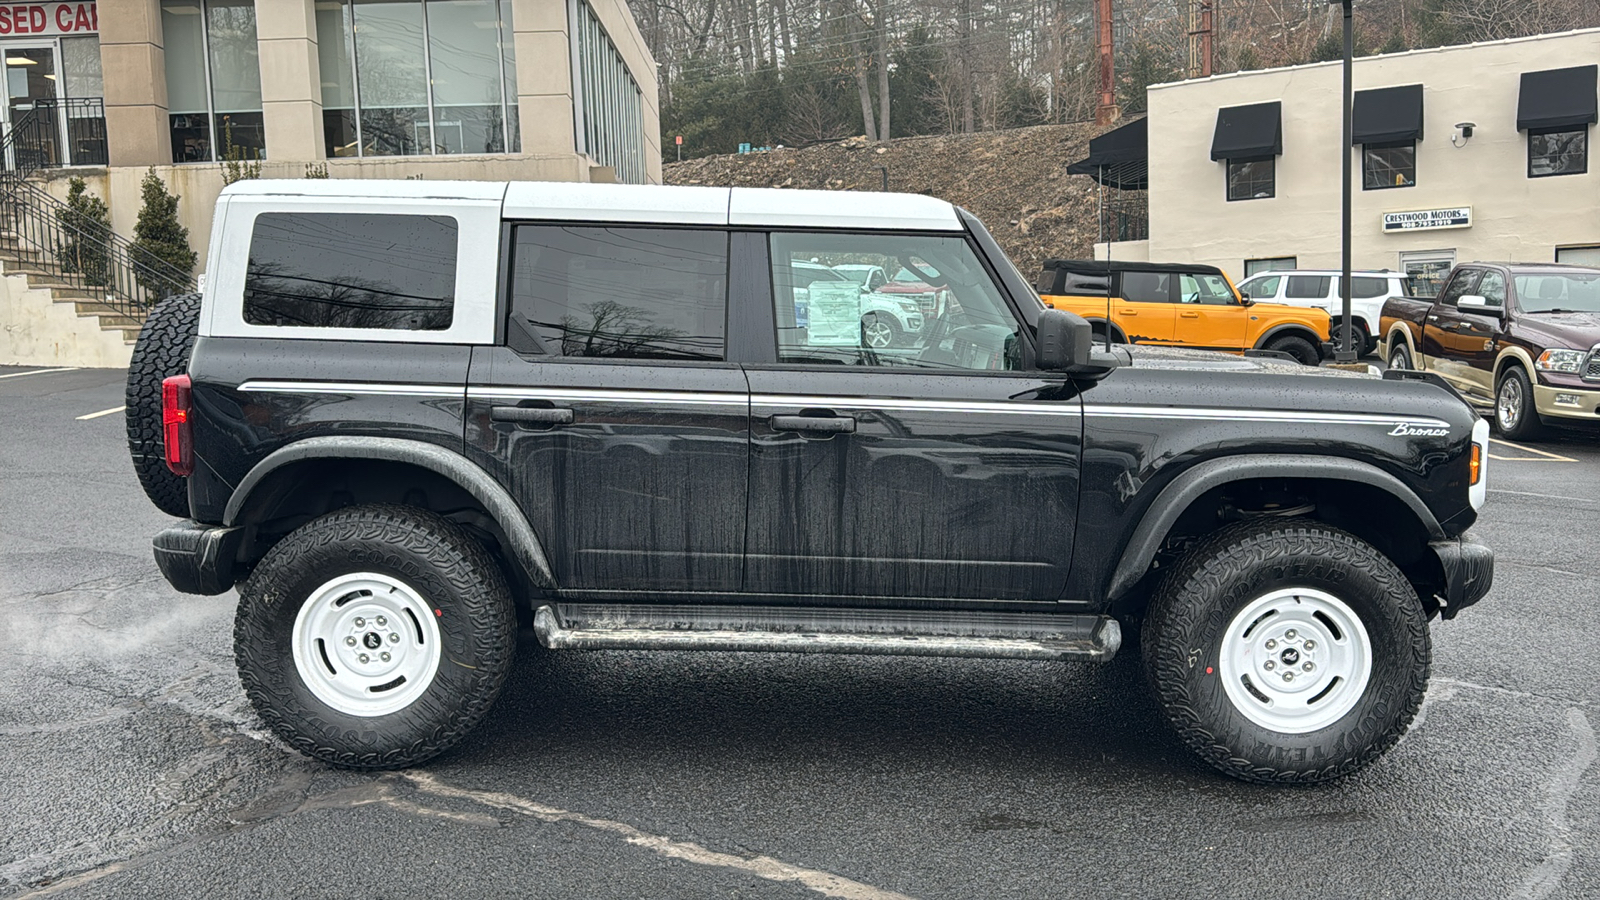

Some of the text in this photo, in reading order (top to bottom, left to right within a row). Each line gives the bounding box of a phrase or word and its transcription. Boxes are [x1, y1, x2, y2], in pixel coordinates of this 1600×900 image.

[1385, 212, 1428, 223] CRESTWOOD
[1416, 272, 1440, 280] OFFICE
[1387, 422, 1450, 436] Bronco
